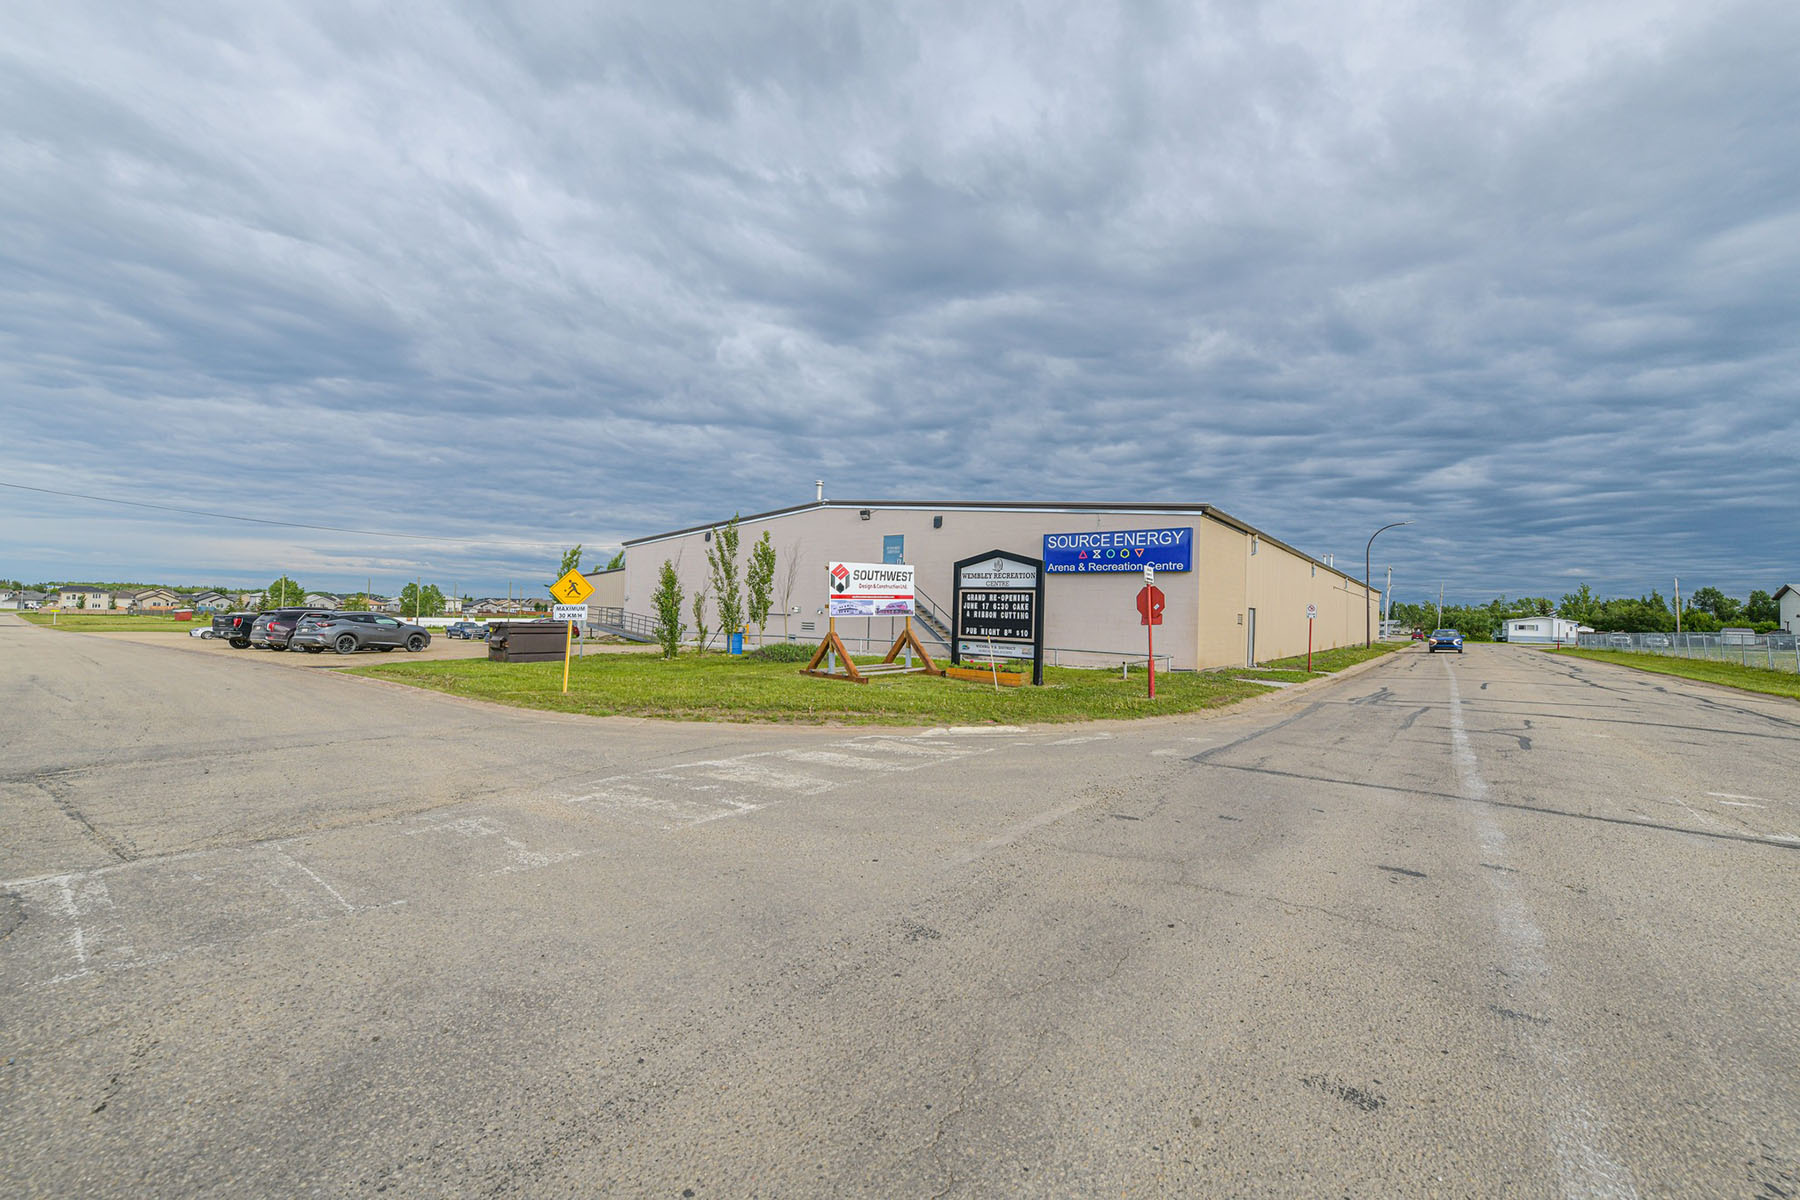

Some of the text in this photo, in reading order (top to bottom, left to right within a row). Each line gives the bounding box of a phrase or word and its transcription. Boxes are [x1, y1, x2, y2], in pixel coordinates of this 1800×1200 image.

[1047, 530, 1184, 549] SOURCE ENERGY
[1047, 561, 1184, 572] Arena & Recreation Centre
[852, 569, 913, 582] SOUTHWEST
[989, 594, 1030, 602] RE-OPENING
[963, 602, 978, 610] JUNE
[982, 602, 989, 610] 17
[1012, 603, 1029, 611] CAKE
[965, 627, 978, 635] PUB
[980, 628, 1000, 636] NIGHT
